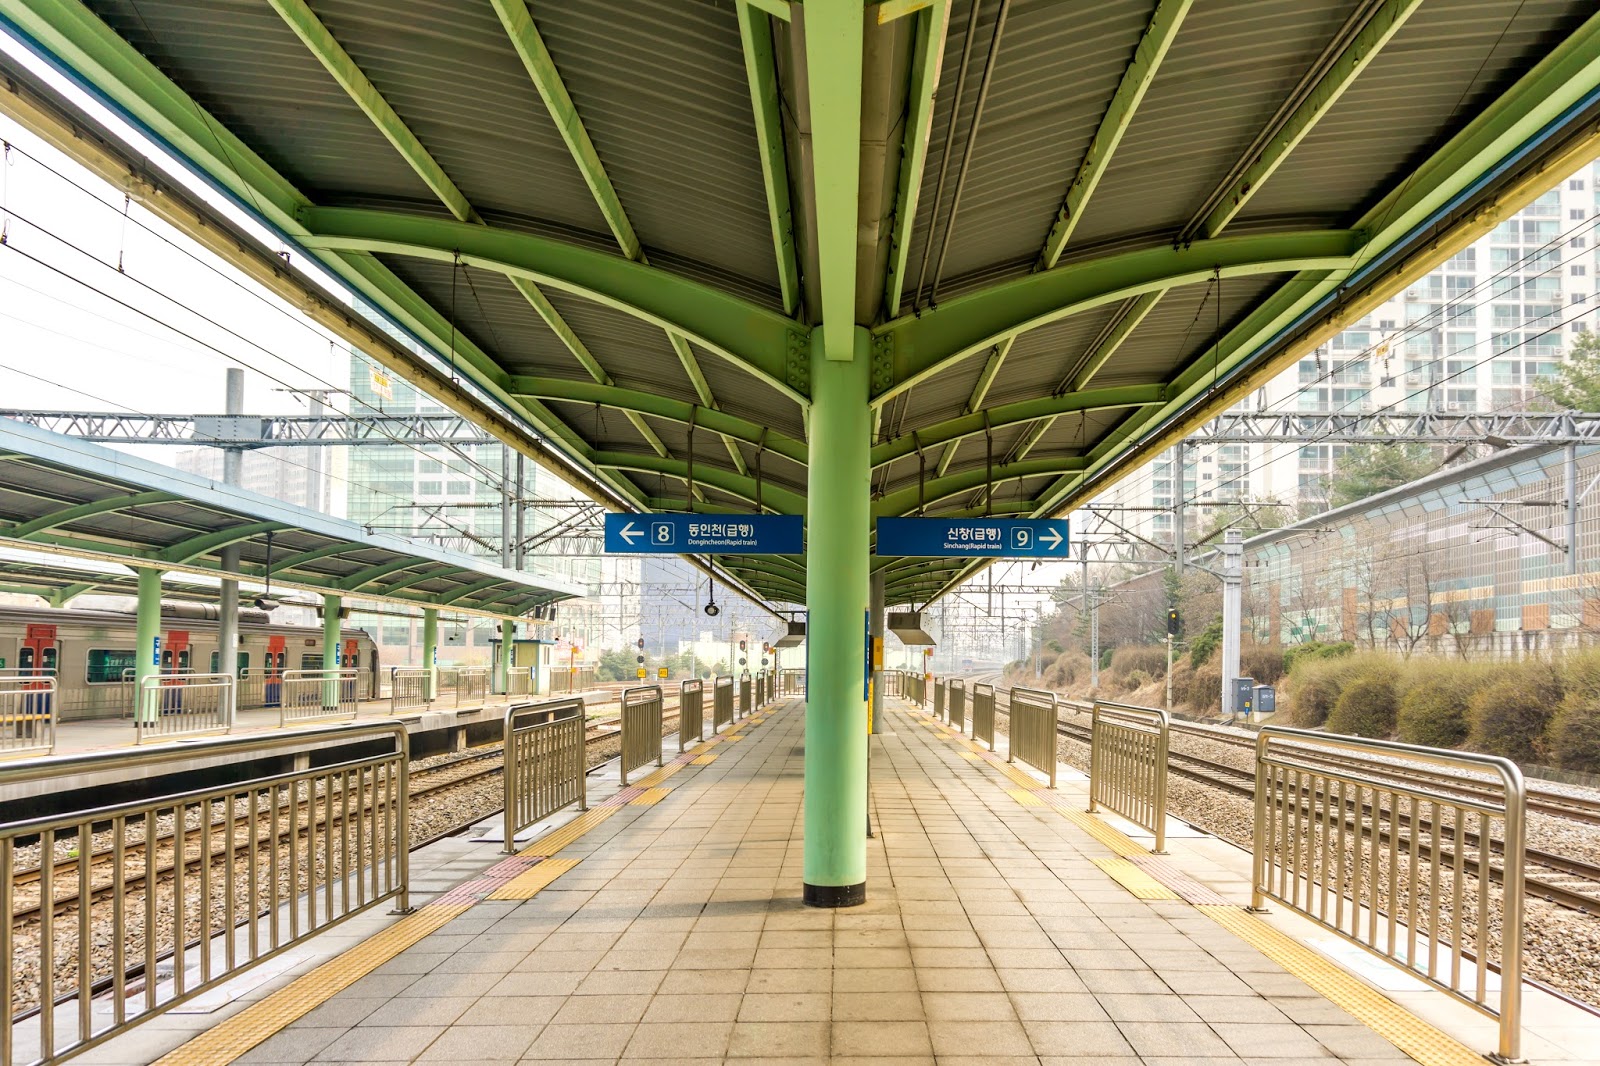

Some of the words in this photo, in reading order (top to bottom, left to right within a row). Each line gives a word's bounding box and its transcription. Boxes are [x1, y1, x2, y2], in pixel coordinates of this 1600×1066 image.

[657, 525, 670, 542] 8
[688, 523, 754, 537] 동인천(급행)
[947, 527, 1001, 541] 신창(급행)
[688, 538, 742, 546] Dongincheon(Rapid
[1016, 530, 1029, 547] 9
[943, 542, 986, 550] Sinchang(Rapid
